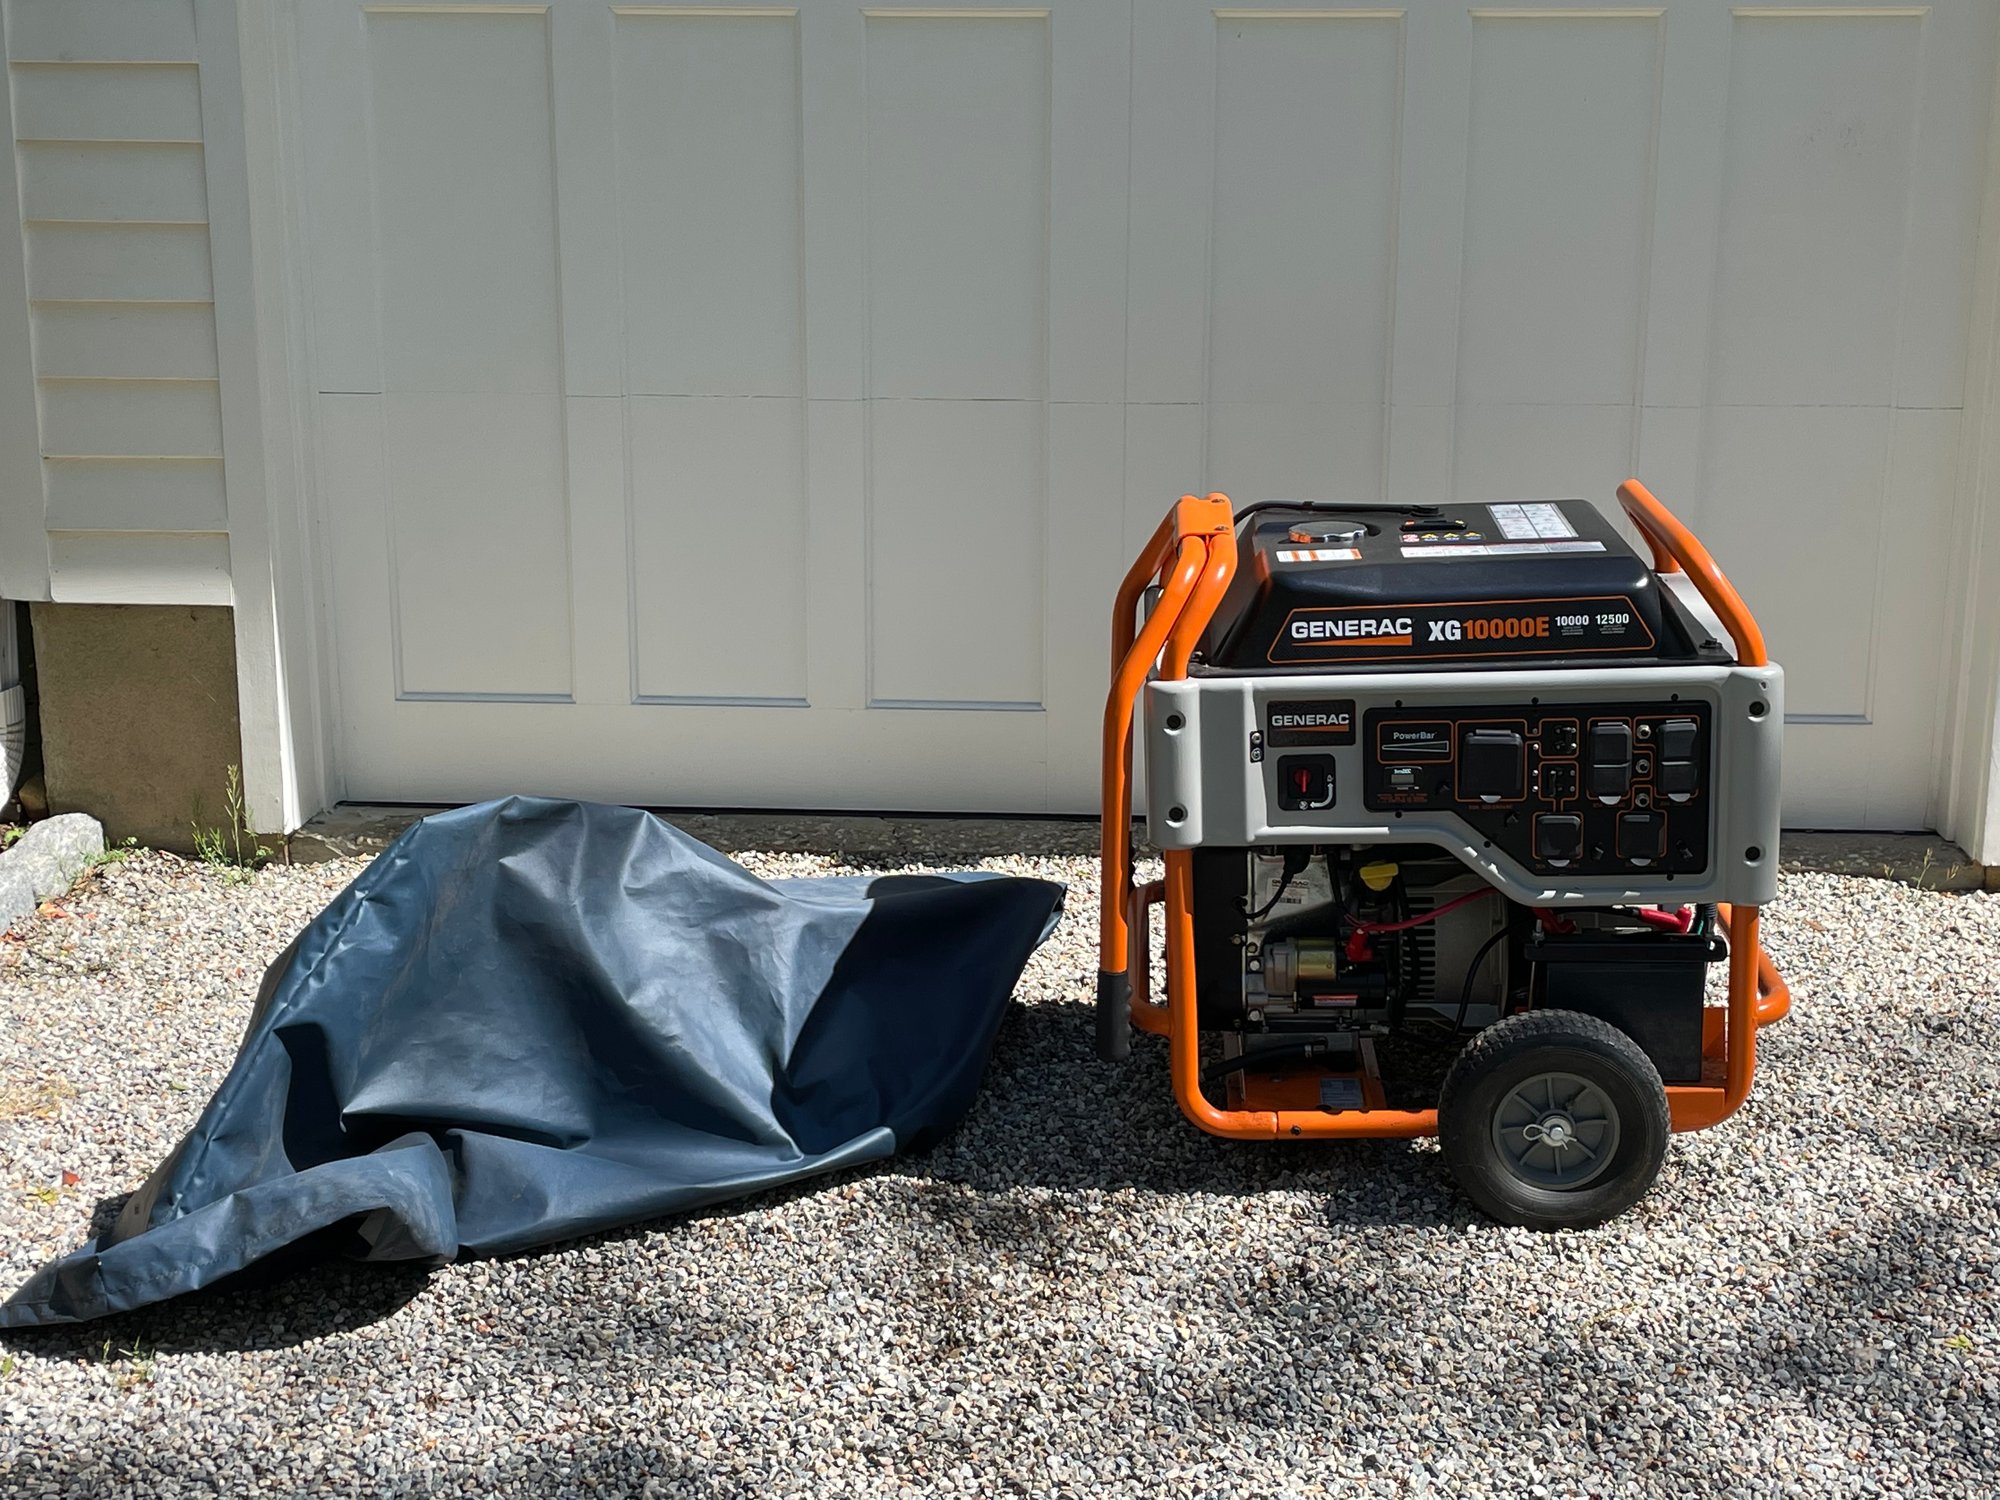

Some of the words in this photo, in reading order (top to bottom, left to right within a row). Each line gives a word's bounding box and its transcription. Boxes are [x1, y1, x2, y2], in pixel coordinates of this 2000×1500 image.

[1291, 618, 1412, 639] GENERAC
[1555, 615, 1590, 627] 10000
[1595, 613, 1630, 625] 12500
[1271, 713, 1350, 727] GENERAC
[1393, 731, 1436, 740] PowerBar
